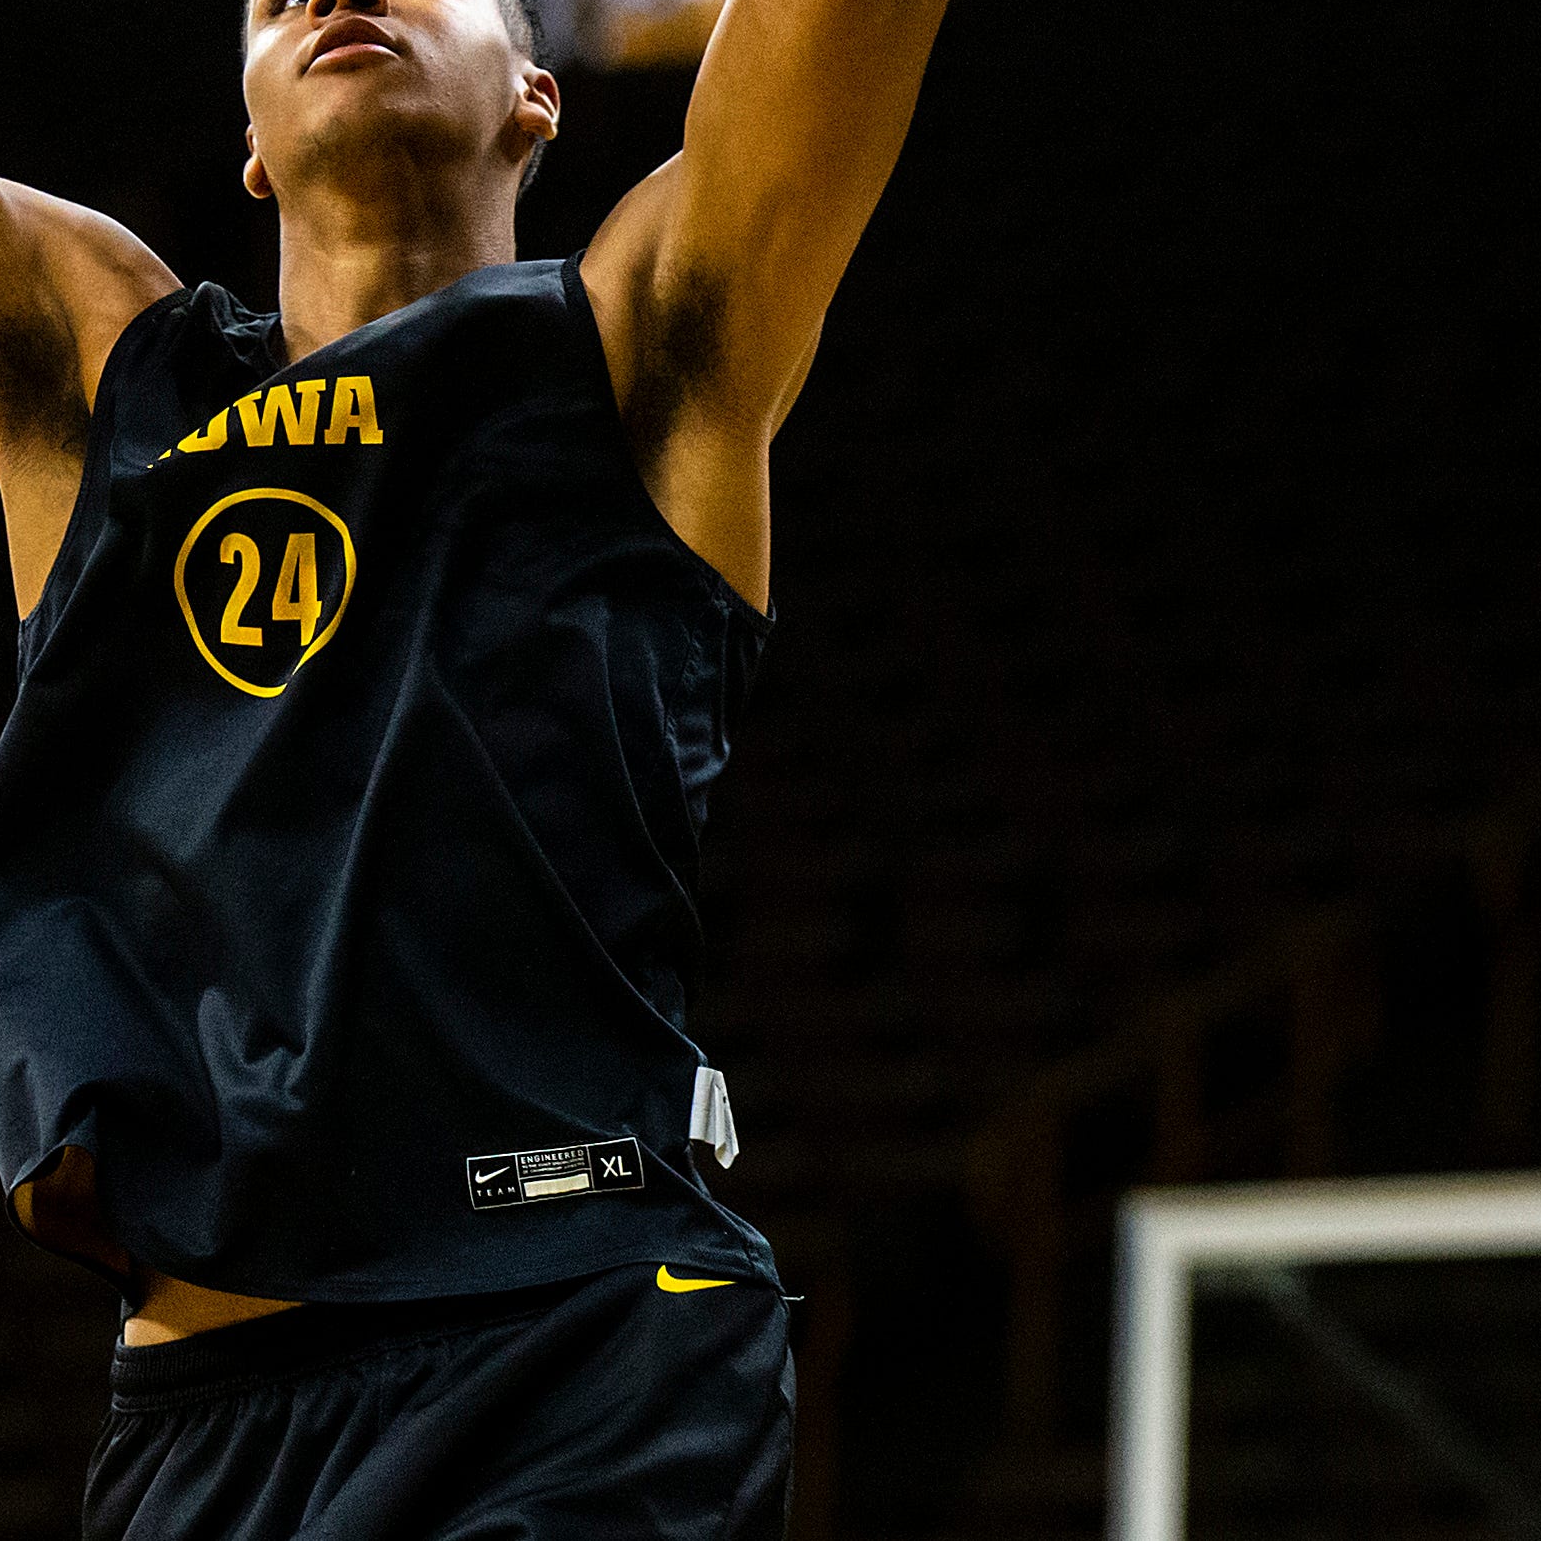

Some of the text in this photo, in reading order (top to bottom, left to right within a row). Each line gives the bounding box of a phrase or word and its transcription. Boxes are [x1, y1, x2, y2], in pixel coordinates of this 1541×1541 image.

[219, 532, 323, 647] 24
[520, 1149, 585, 1165] ENGINEERED
[600, 1155, 633, 1178] XL
[476, 1186, 516, 1197] TEAM
